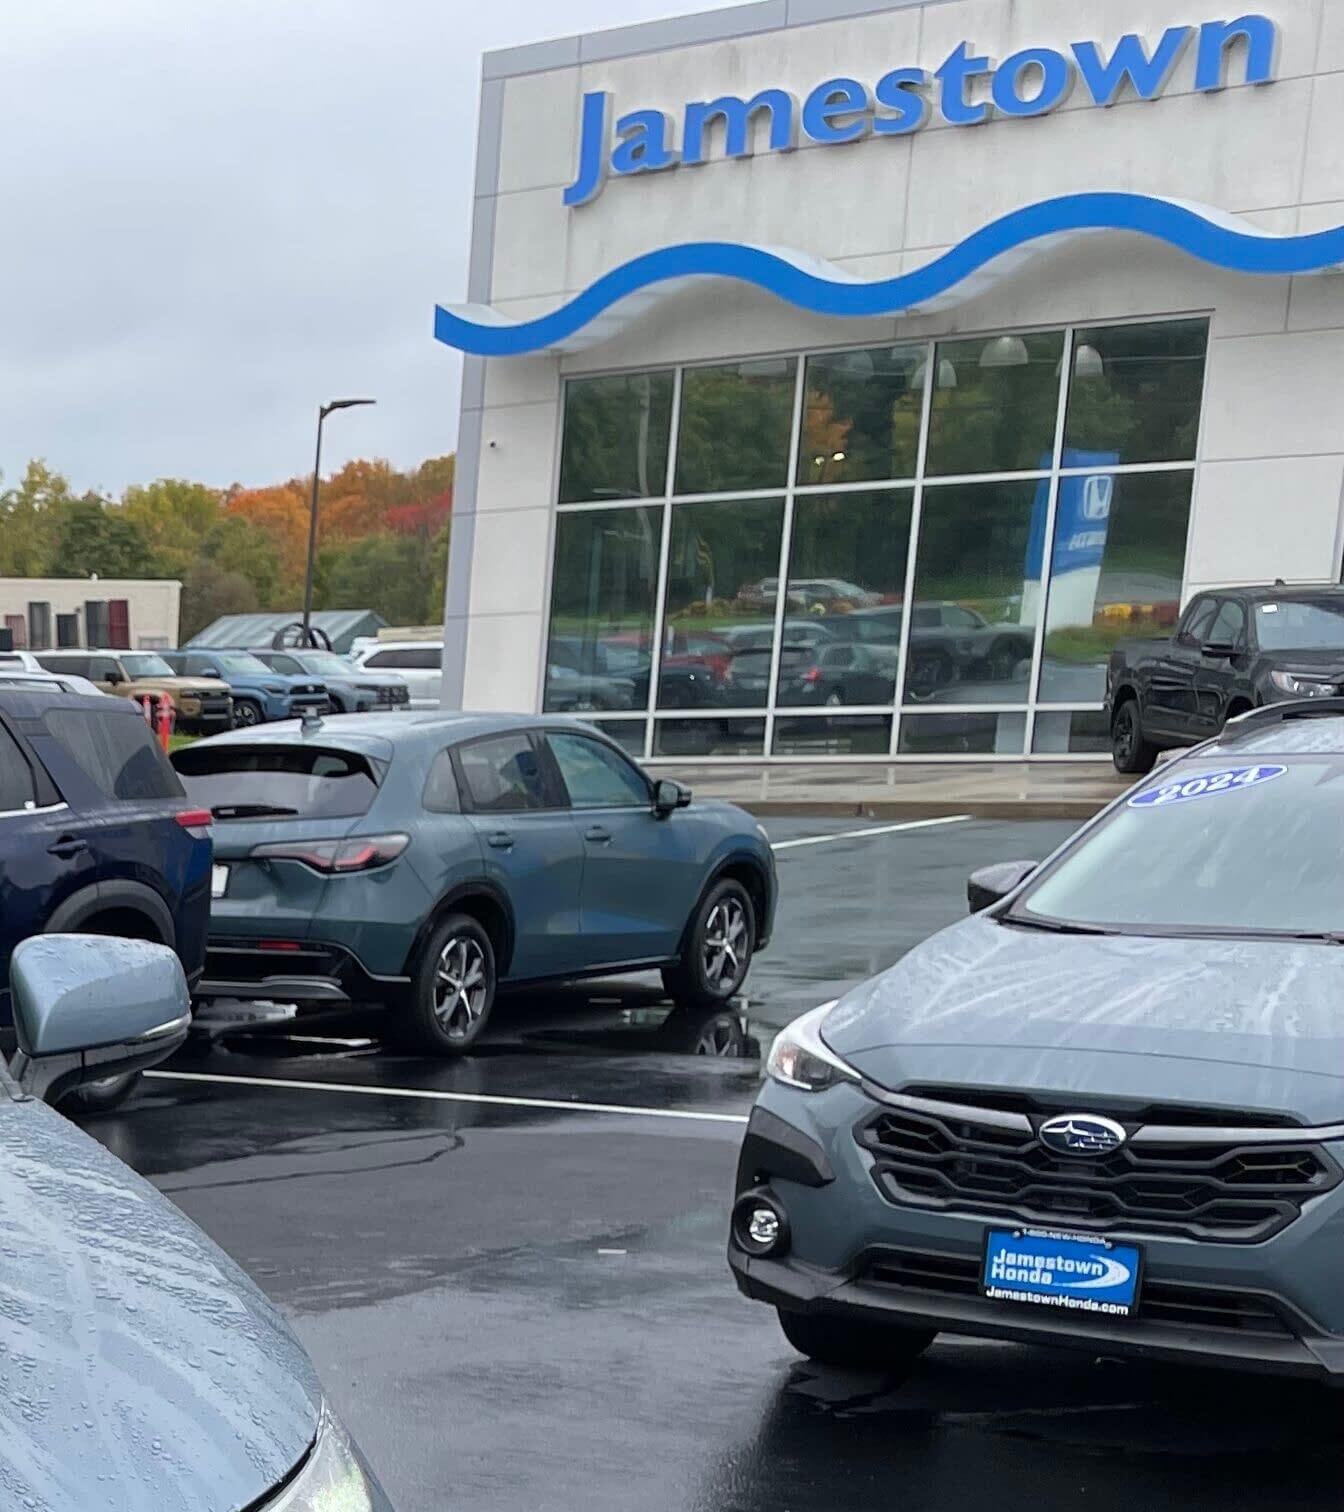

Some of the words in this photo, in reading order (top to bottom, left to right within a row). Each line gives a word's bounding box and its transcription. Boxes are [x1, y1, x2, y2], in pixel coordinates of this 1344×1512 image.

[563, 13, 1278, 207] Jamestown
[1154, 766, 1261, 804] 2024
[990, 1263, 1053, 1285] Honda
[992, 1248, 1104, 1277] Jamestown
[985, 1285, 1129, 1316] JamestownHonda.com
